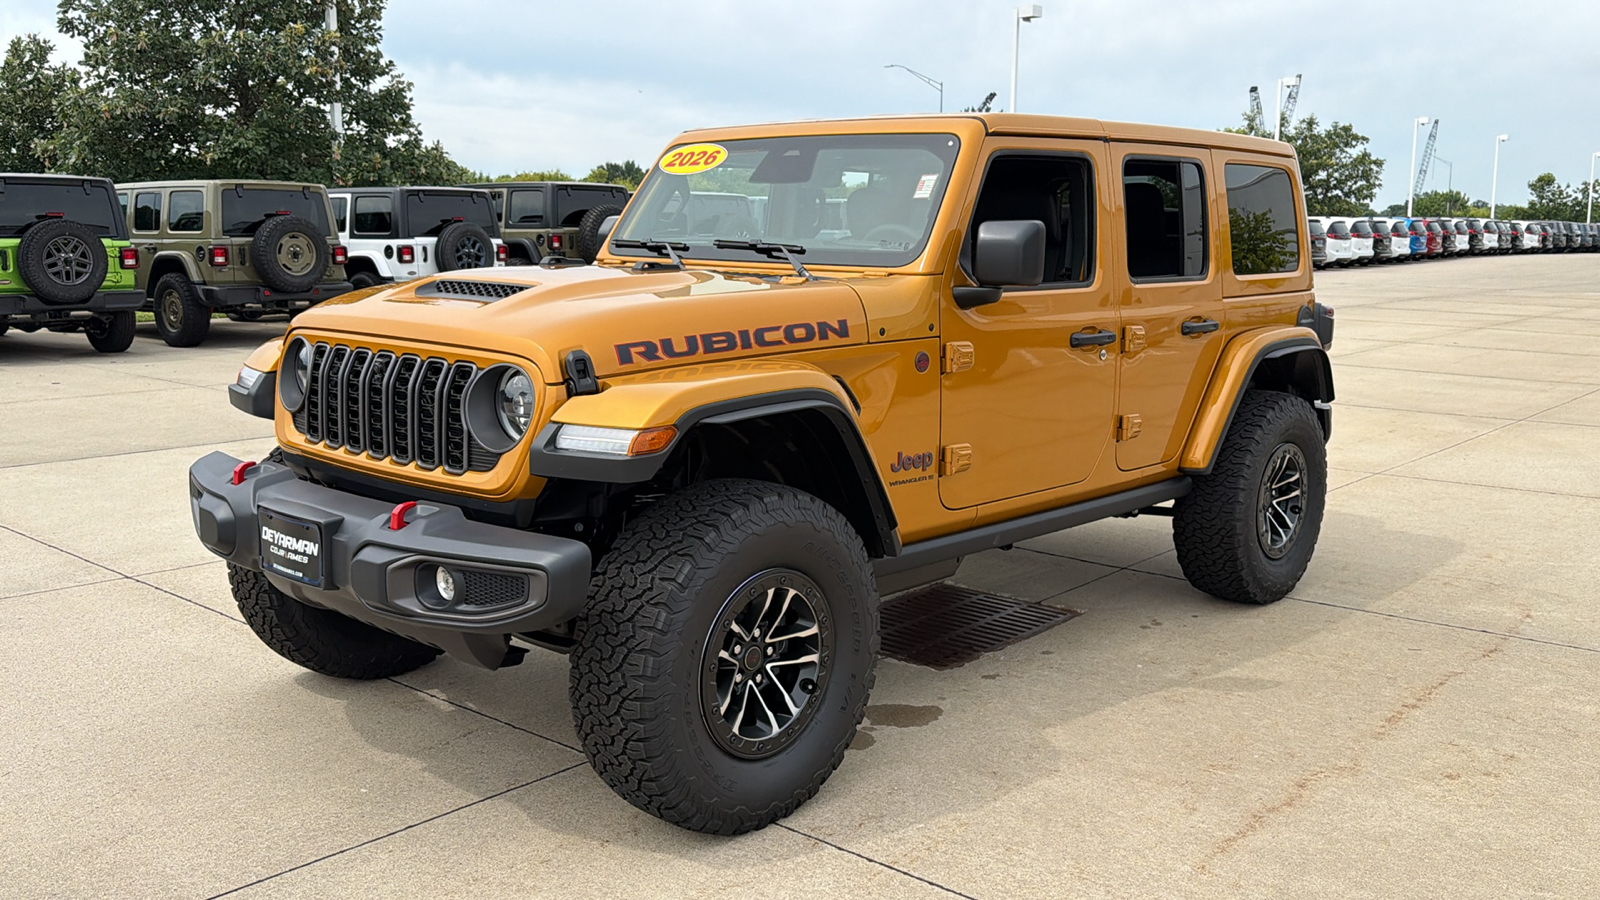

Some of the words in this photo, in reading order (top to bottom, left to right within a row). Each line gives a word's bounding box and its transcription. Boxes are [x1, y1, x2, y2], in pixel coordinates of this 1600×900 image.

[664, 150, 721, 168] 2026
[614, 319, 850, 366] RUBICON
[890, 451, 933, 473] Jeep
[889, 476, 928, 487] WRANGLER
[262, 526, 318, 556] DEYARMAN
